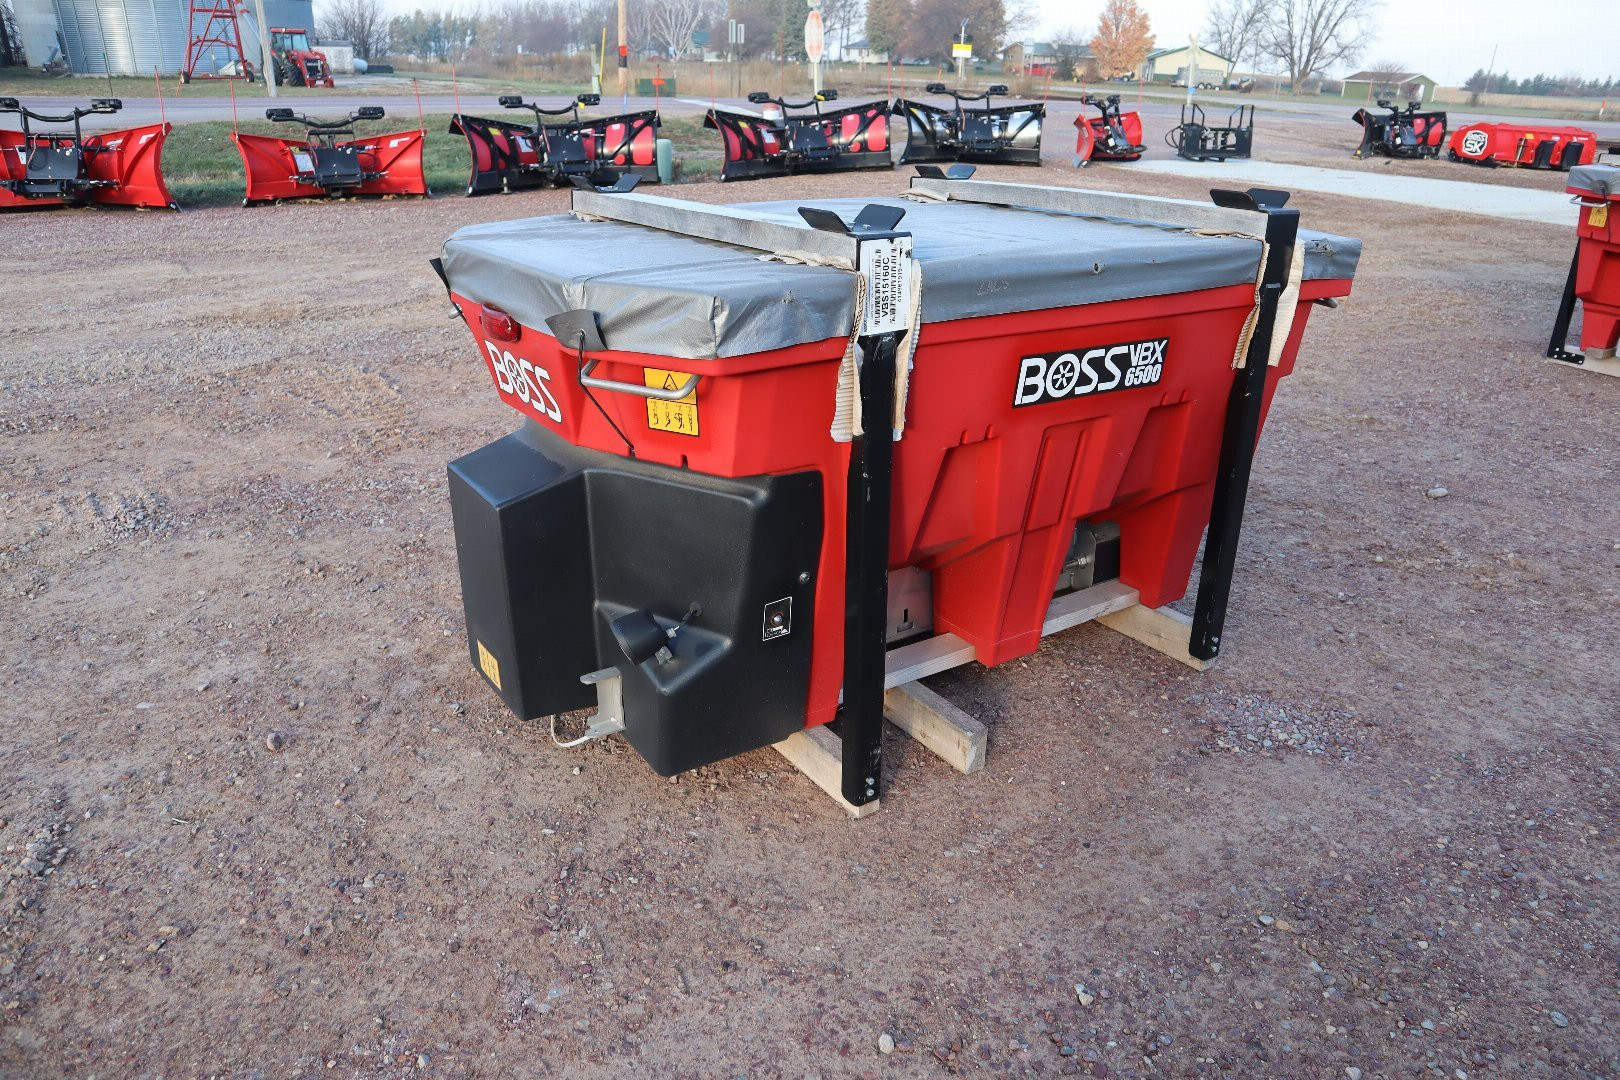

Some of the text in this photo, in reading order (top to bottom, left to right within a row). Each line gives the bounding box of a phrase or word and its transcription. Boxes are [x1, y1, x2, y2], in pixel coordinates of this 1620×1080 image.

[1464, 140, 1483, 152] SK
[1467, 133, 1486, 142] BOSS
[882, 257, 890, 318] VBS15160C
[484, 339, 562, 423] BOSS
[1014, 339, 1168, 405] BOSS VBX
[1124, 364, 1163, 387] 6500
